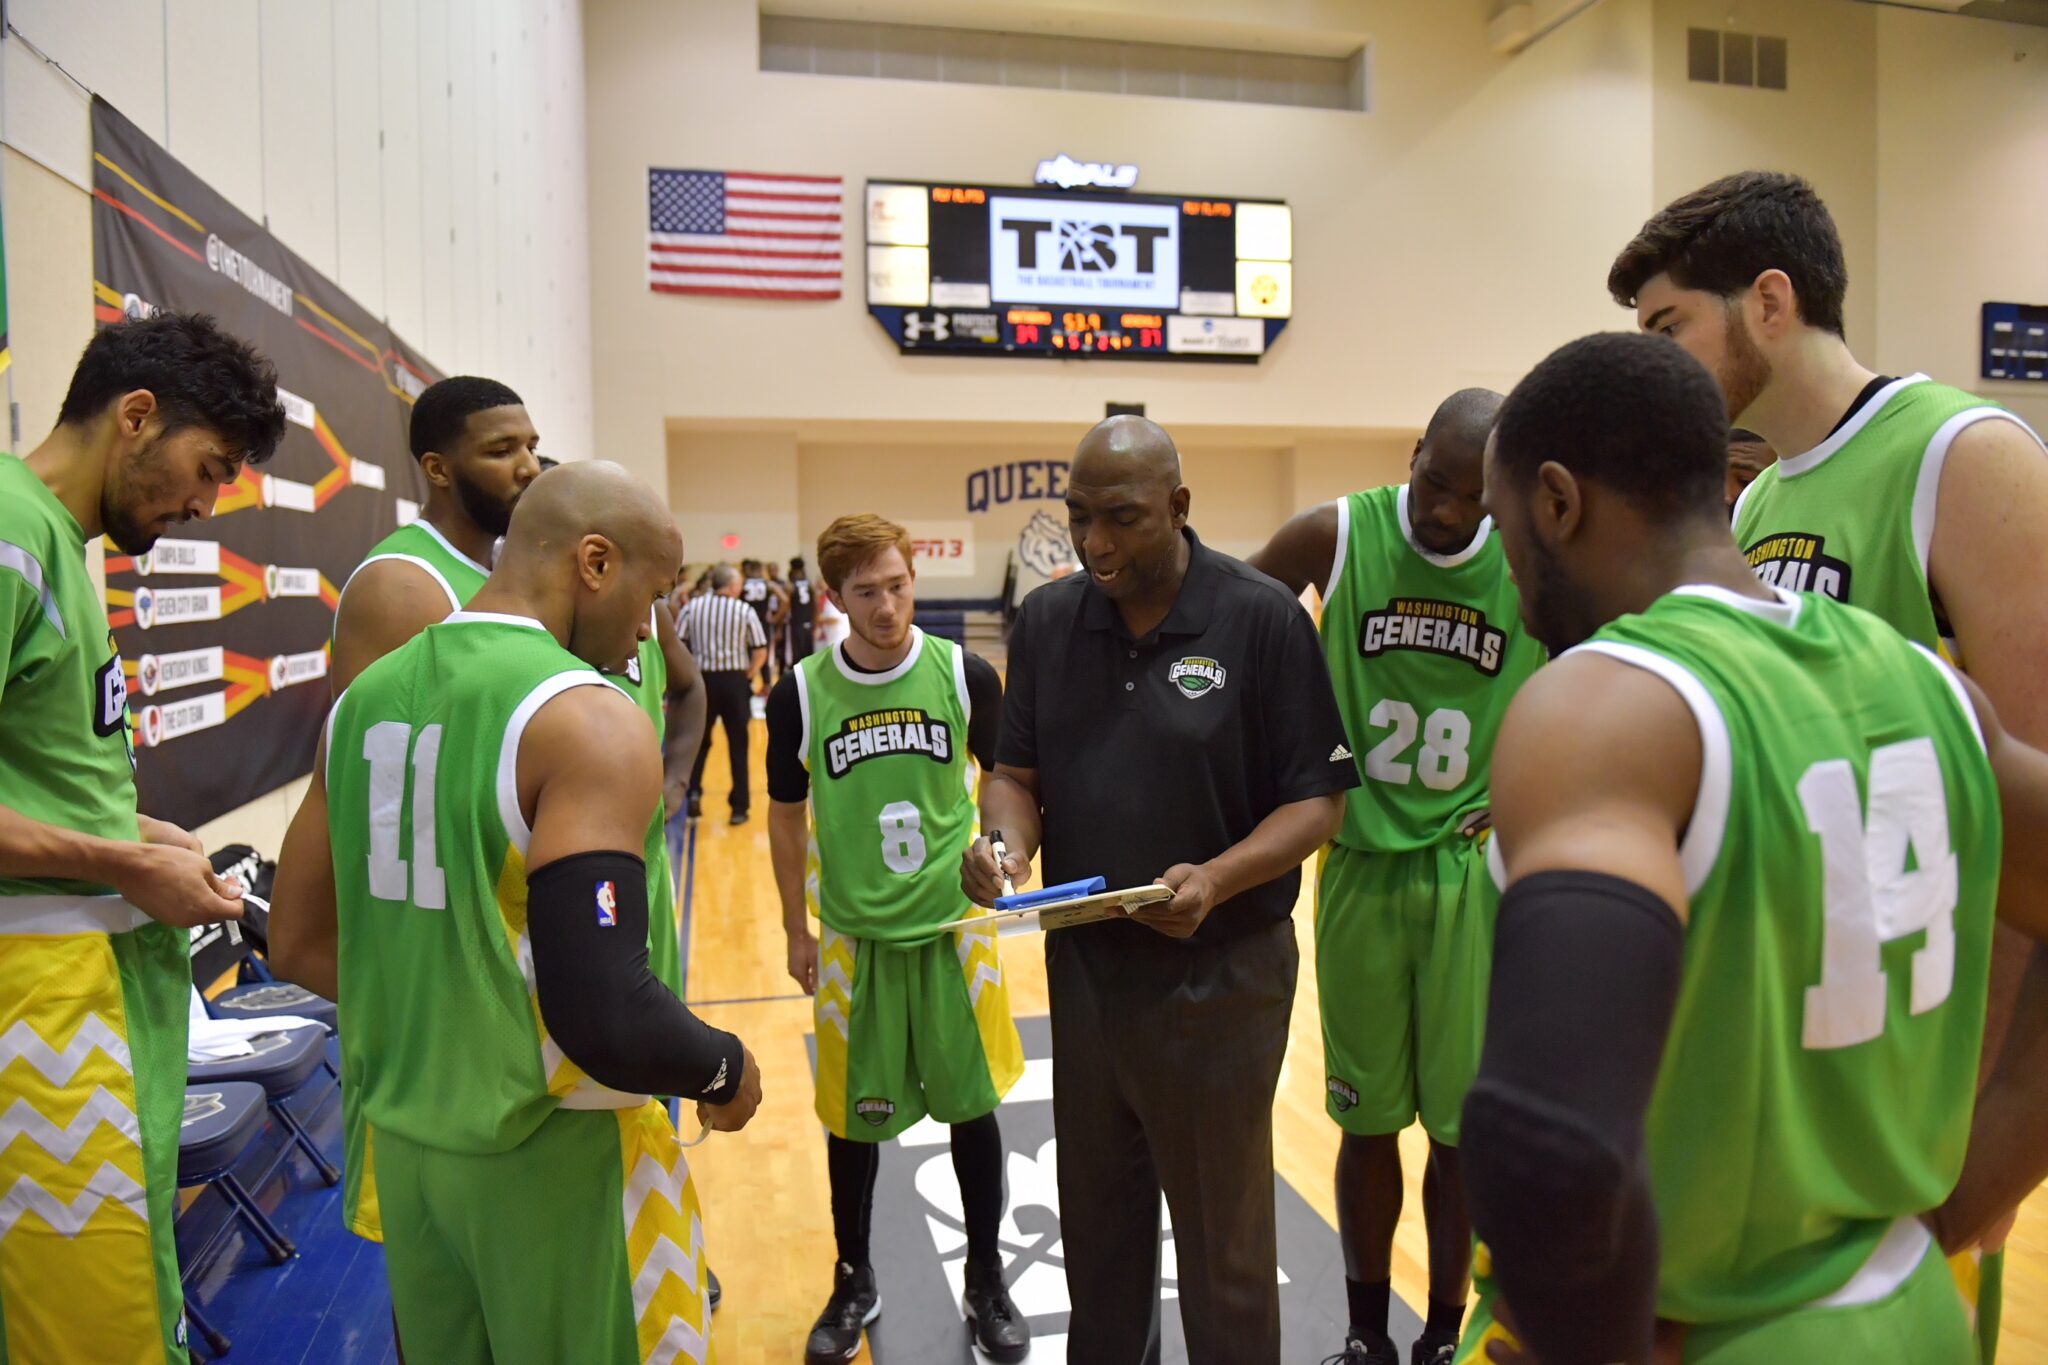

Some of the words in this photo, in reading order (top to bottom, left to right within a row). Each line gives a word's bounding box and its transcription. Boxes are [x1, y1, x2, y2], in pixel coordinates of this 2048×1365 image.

[967, 461, 1069, 513] QUEE
[1396, 601, 1478, 625] WASHINGTON
[1364, 615, 1502, 671] GENERALS
[1172, 664, 1223, 685] GENERALS
[849, 710, 922, 732] WASHINGTON
[1365, 698, 1471, 791] 28
[829, 723, 948, 774] GENERALS
[362, 720, 447, 910] 11
[879, 800, 927, 874] 8
[1796, 736, 1959, 1050] 14
